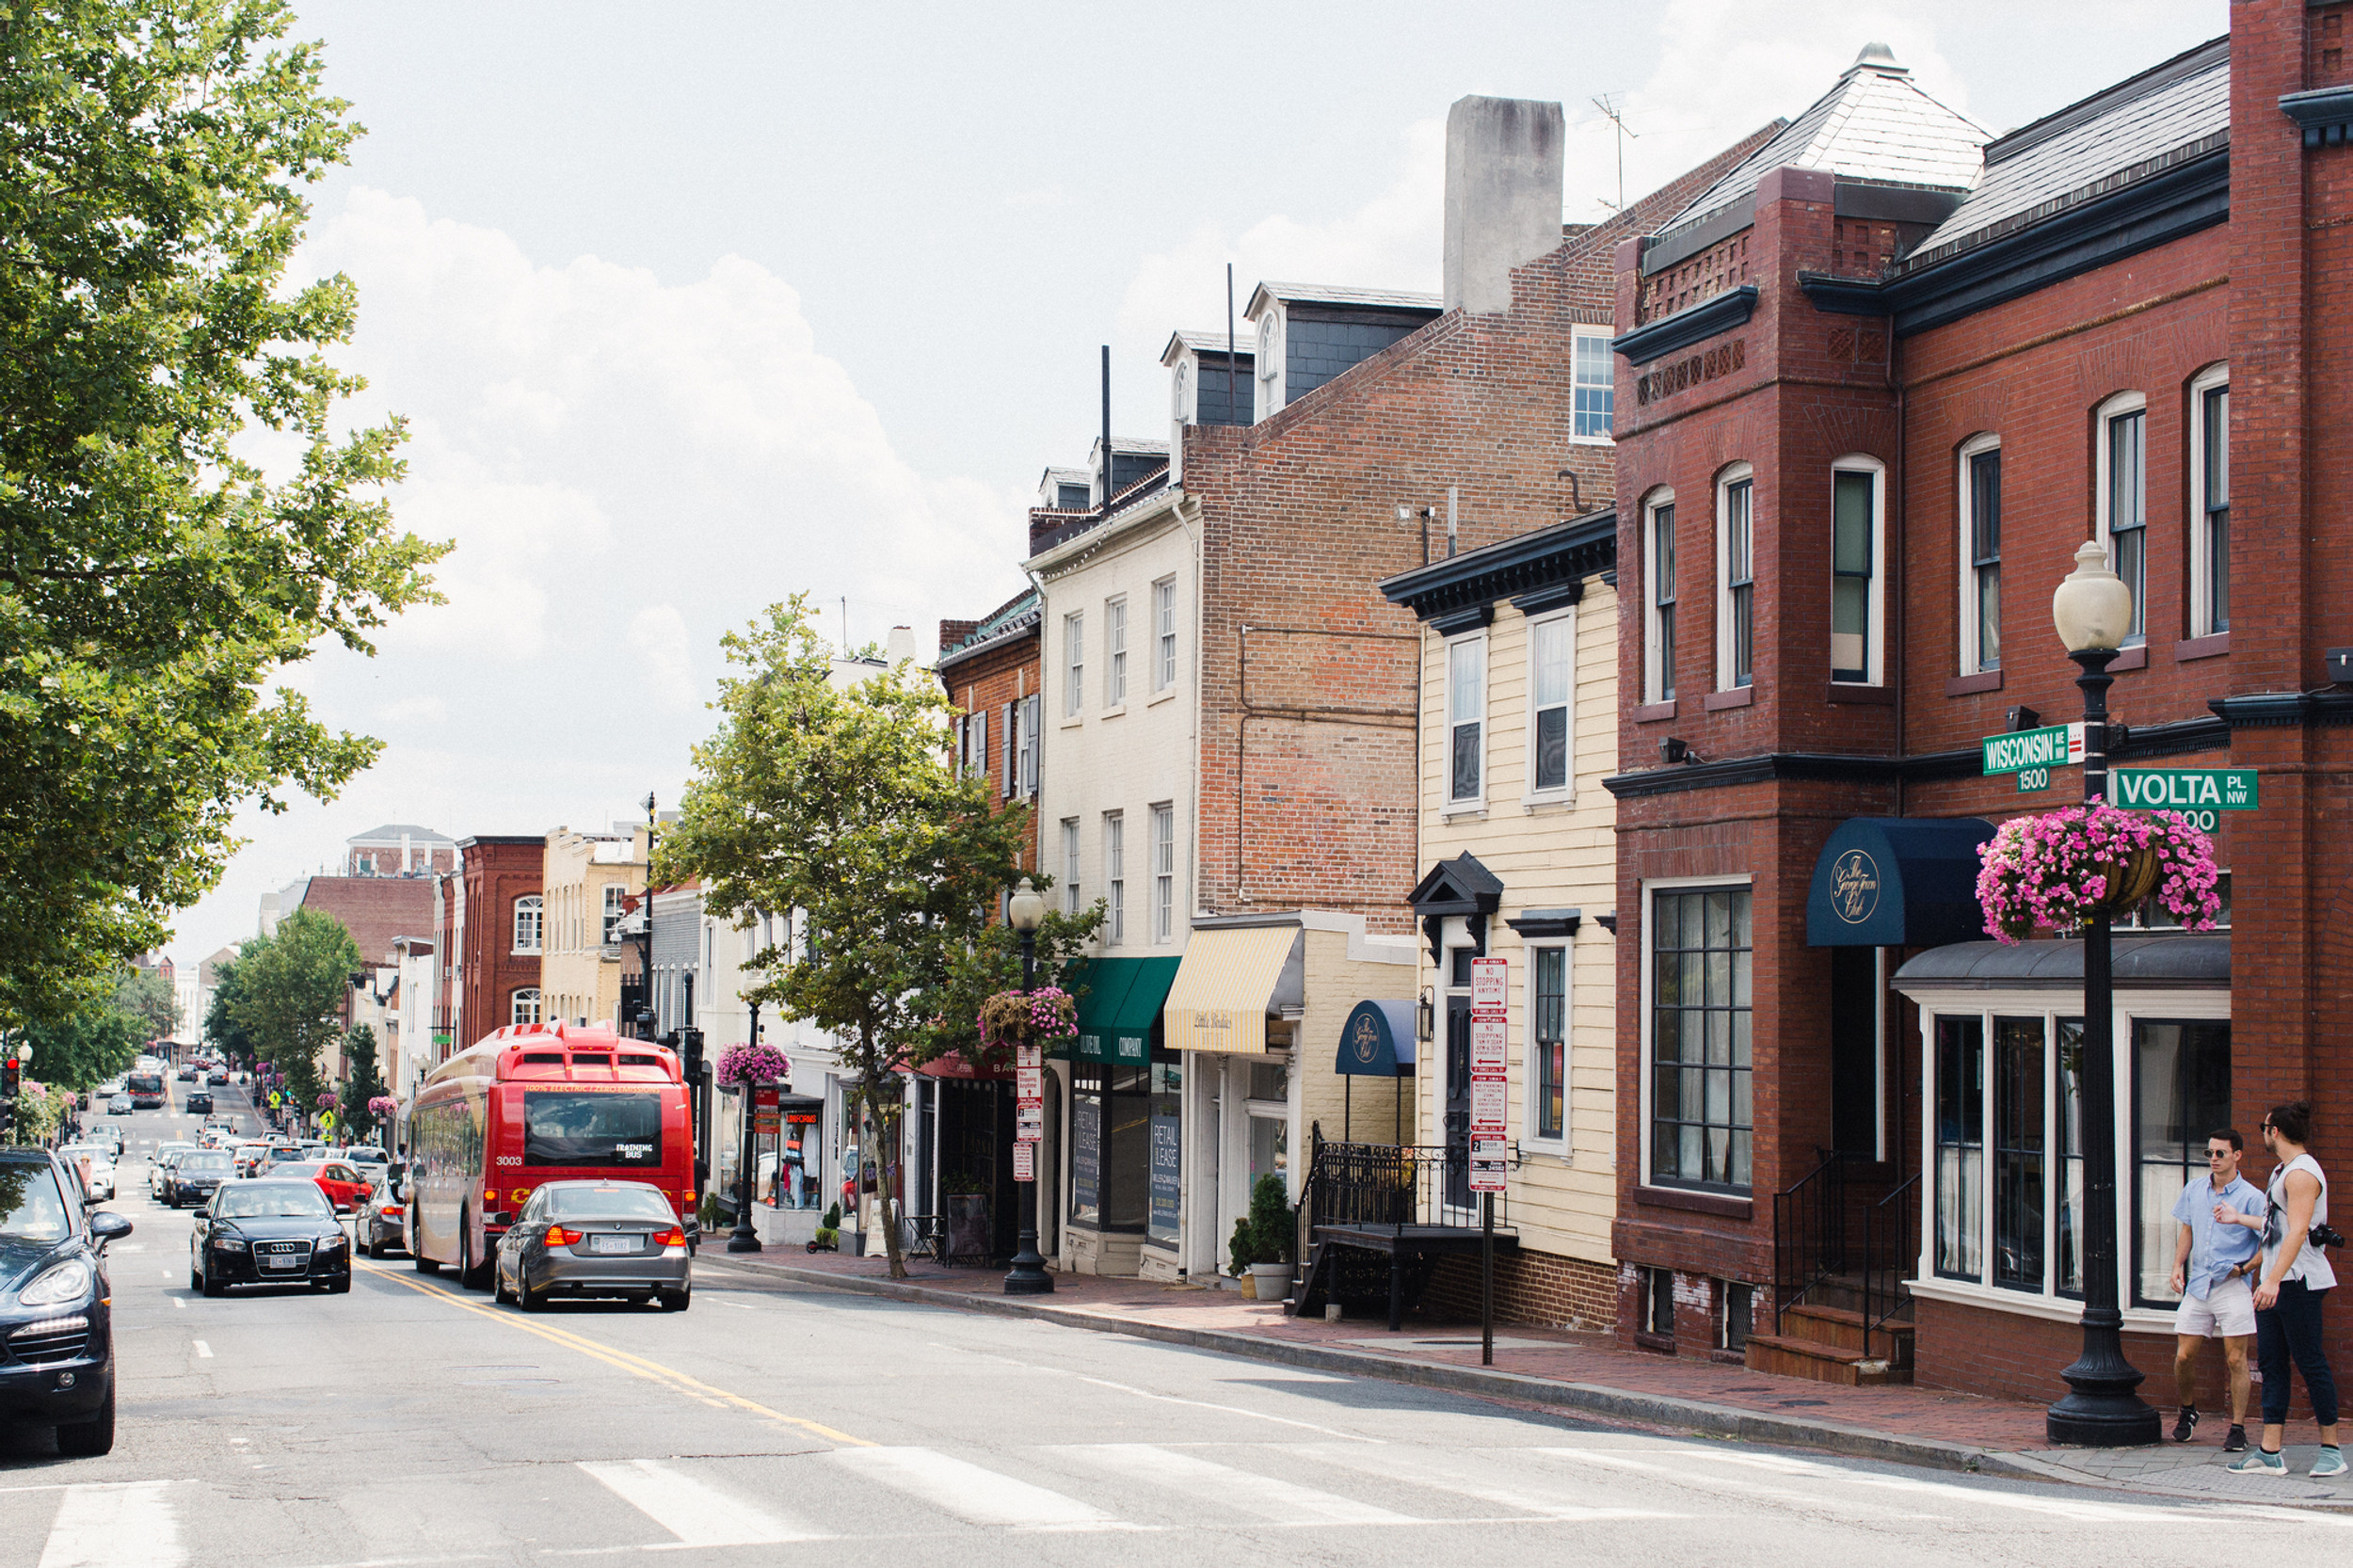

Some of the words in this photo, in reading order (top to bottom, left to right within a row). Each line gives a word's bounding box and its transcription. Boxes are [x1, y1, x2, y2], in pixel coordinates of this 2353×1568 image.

[2055, 731, 2064, 744] AVE
[1986, 733, 2053, 769] WISCONSIN
[2055, 746, 2065, 760] NW
[2019, 768, 2047, 790] 1500
[2227, 776, 2247, 789] PL
[2121, 775, 2221, 804] VOLTA
[2227, 792, 2247, 804] NW
[1849, 856, 1862, 878] The
[1846, 890, 1865, 918] Club
[1485, 967, 1494, 976] NO
[1475, 976, 1503, 986] STOPPING
[1119, 1036, 1142, 1057] COMPANY
[786, 1114, 816, 1123] UNIFORMS
[1154, 1125, 1176, 1145] RETAIL
[1474, 1141, 1480, 1151] 2
[496, 1156, 522, 1165] 3003
[1156, 1148, 1176, 1167] LEASE
